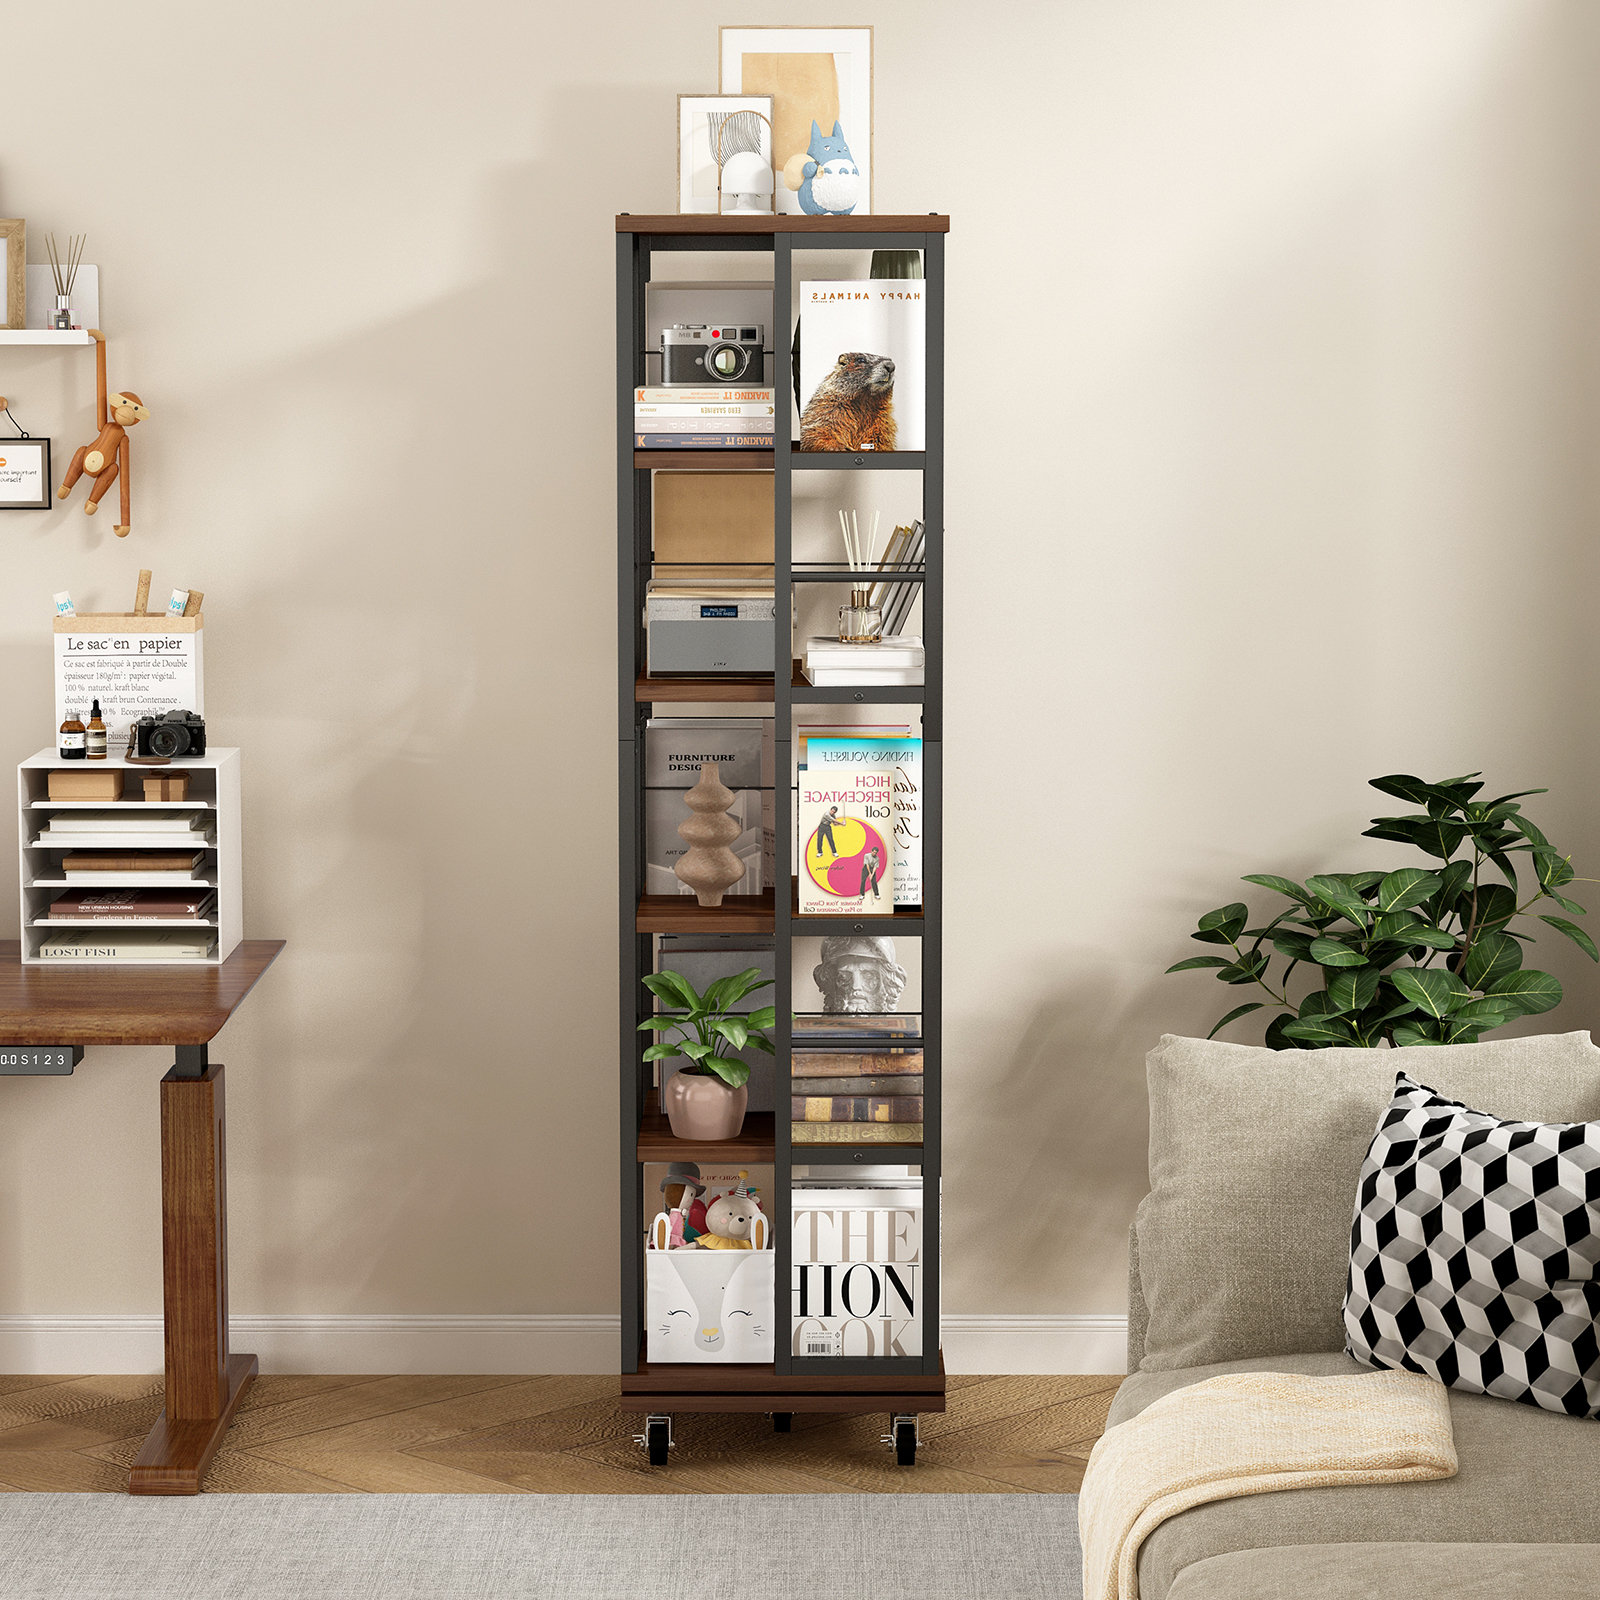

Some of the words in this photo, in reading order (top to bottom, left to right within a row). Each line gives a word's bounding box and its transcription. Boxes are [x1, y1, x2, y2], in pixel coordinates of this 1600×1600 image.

[723, 391, 732, 400] IT
[734, 391, 770, 400] MAKING
[725, 436, 735, 446] IT
[737, 436, 774, 446] MAKING
[68, 638, 84, 650] Le
[114, 640, 130, 650] en
[140, 637, 182, 654] papier
[64, 660, 74, 668] Ce
[96, 659, 124, 670] fabriqué
[132, 659, 151, 670] partir
[152, 659, 161, 668] de
[162, 659, 188, 668] Double
[64, 672, 94, 682] épaisseur
[129, 672, 151, 682] papier
[65, 684, 77, 692] 100
[78, 684, 86, 692] %
[114, 683, 130, 692] kraft
[131, 683, 150, 692] blanc
[64, 695, 89, 704] doublé
[102, 695, 118, 704] kraft
[119, 695, 136, 704] brun
[21, 1055, 28, 1065] S
[33, 1055, 38, 1064] 1
[44, 1055, 52, 1064] 2
[57, 1055, 64, 1065] 3
[794, 1210, 919, 1262] THE
